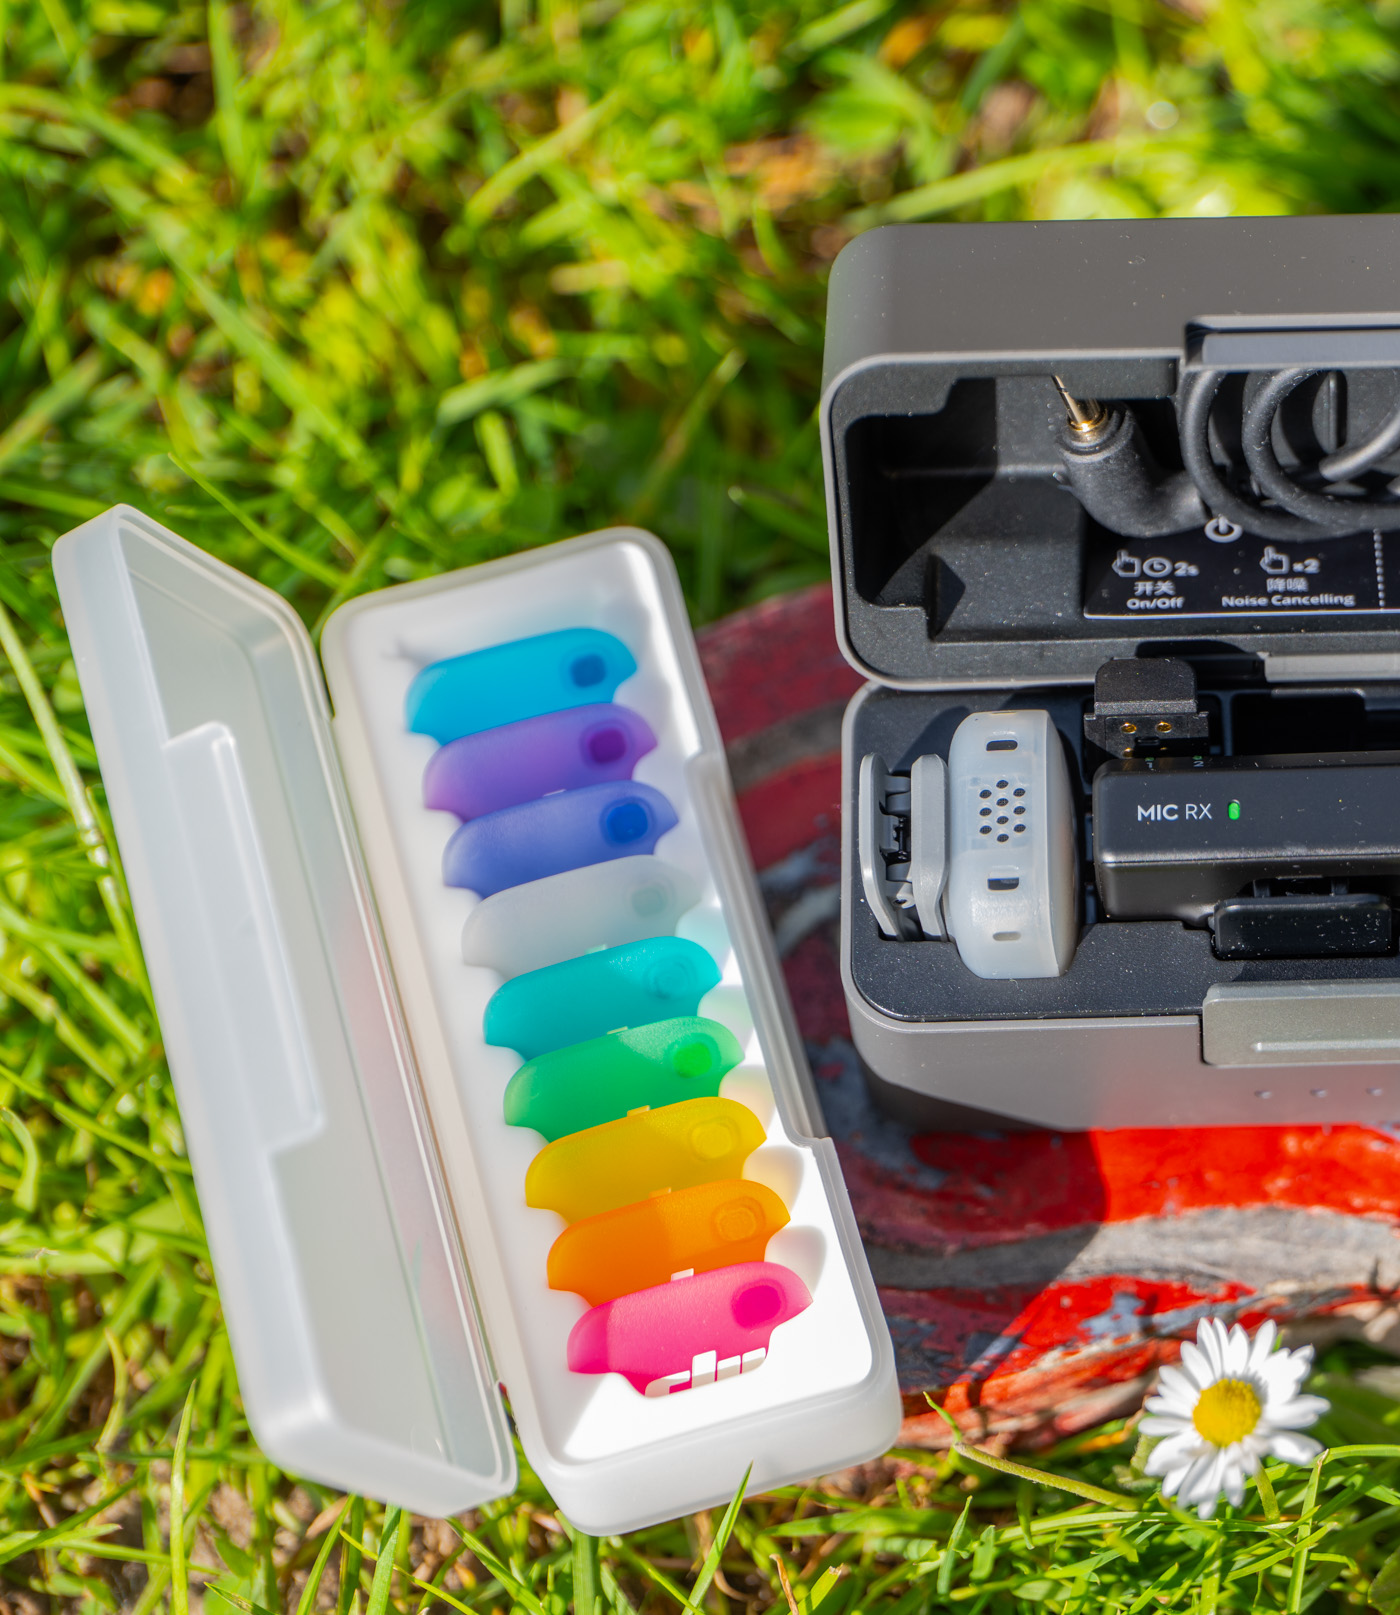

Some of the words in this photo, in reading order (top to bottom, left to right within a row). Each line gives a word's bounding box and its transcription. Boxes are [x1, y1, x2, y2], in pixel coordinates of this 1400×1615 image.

[1174, 561, 1200, 577] 2s
[1134, 580, 1176, 597] 开关
[1266, 577, 1310, 594] 降噪
[1126, 596, 1185, 610] On/Off
[1221, 595, 1269, 608] Noise
[1271, 593, 1356, 608] Cancelling
[1137, 803, 1179, 822] MIC
[1185, 803, 1213, 820] RX
